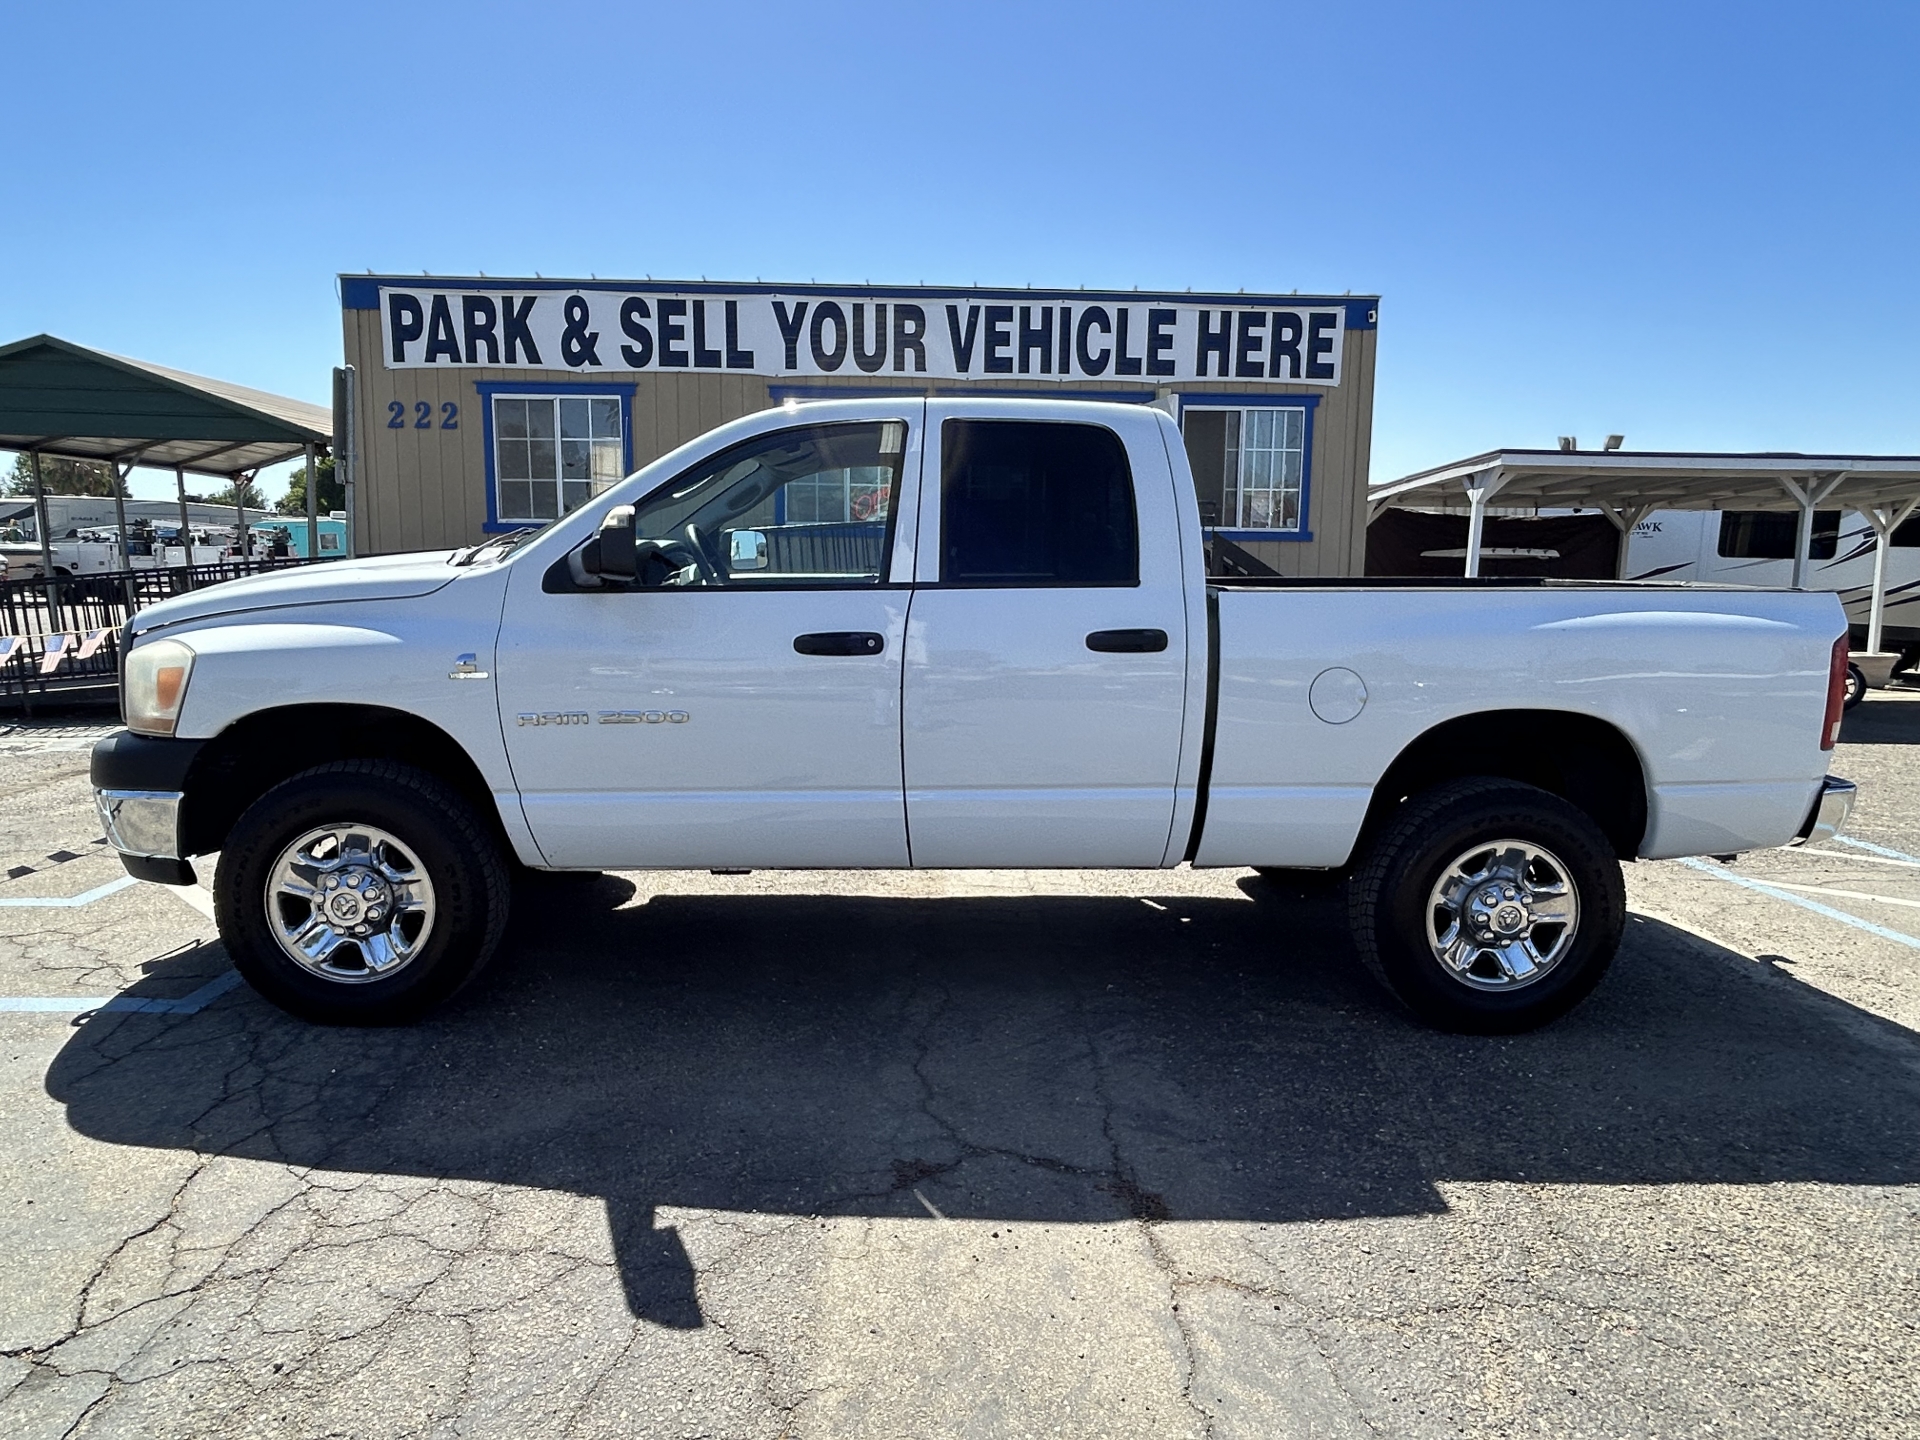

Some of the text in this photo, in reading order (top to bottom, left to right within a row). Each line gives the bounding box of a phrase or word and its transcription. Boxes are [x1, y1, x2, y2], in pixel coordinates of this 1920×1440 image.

[388, 292, 1338, 380] PARK & SELL YOUR VEHICLE HERE
[517, 709, 690, 726] RAM 2500
